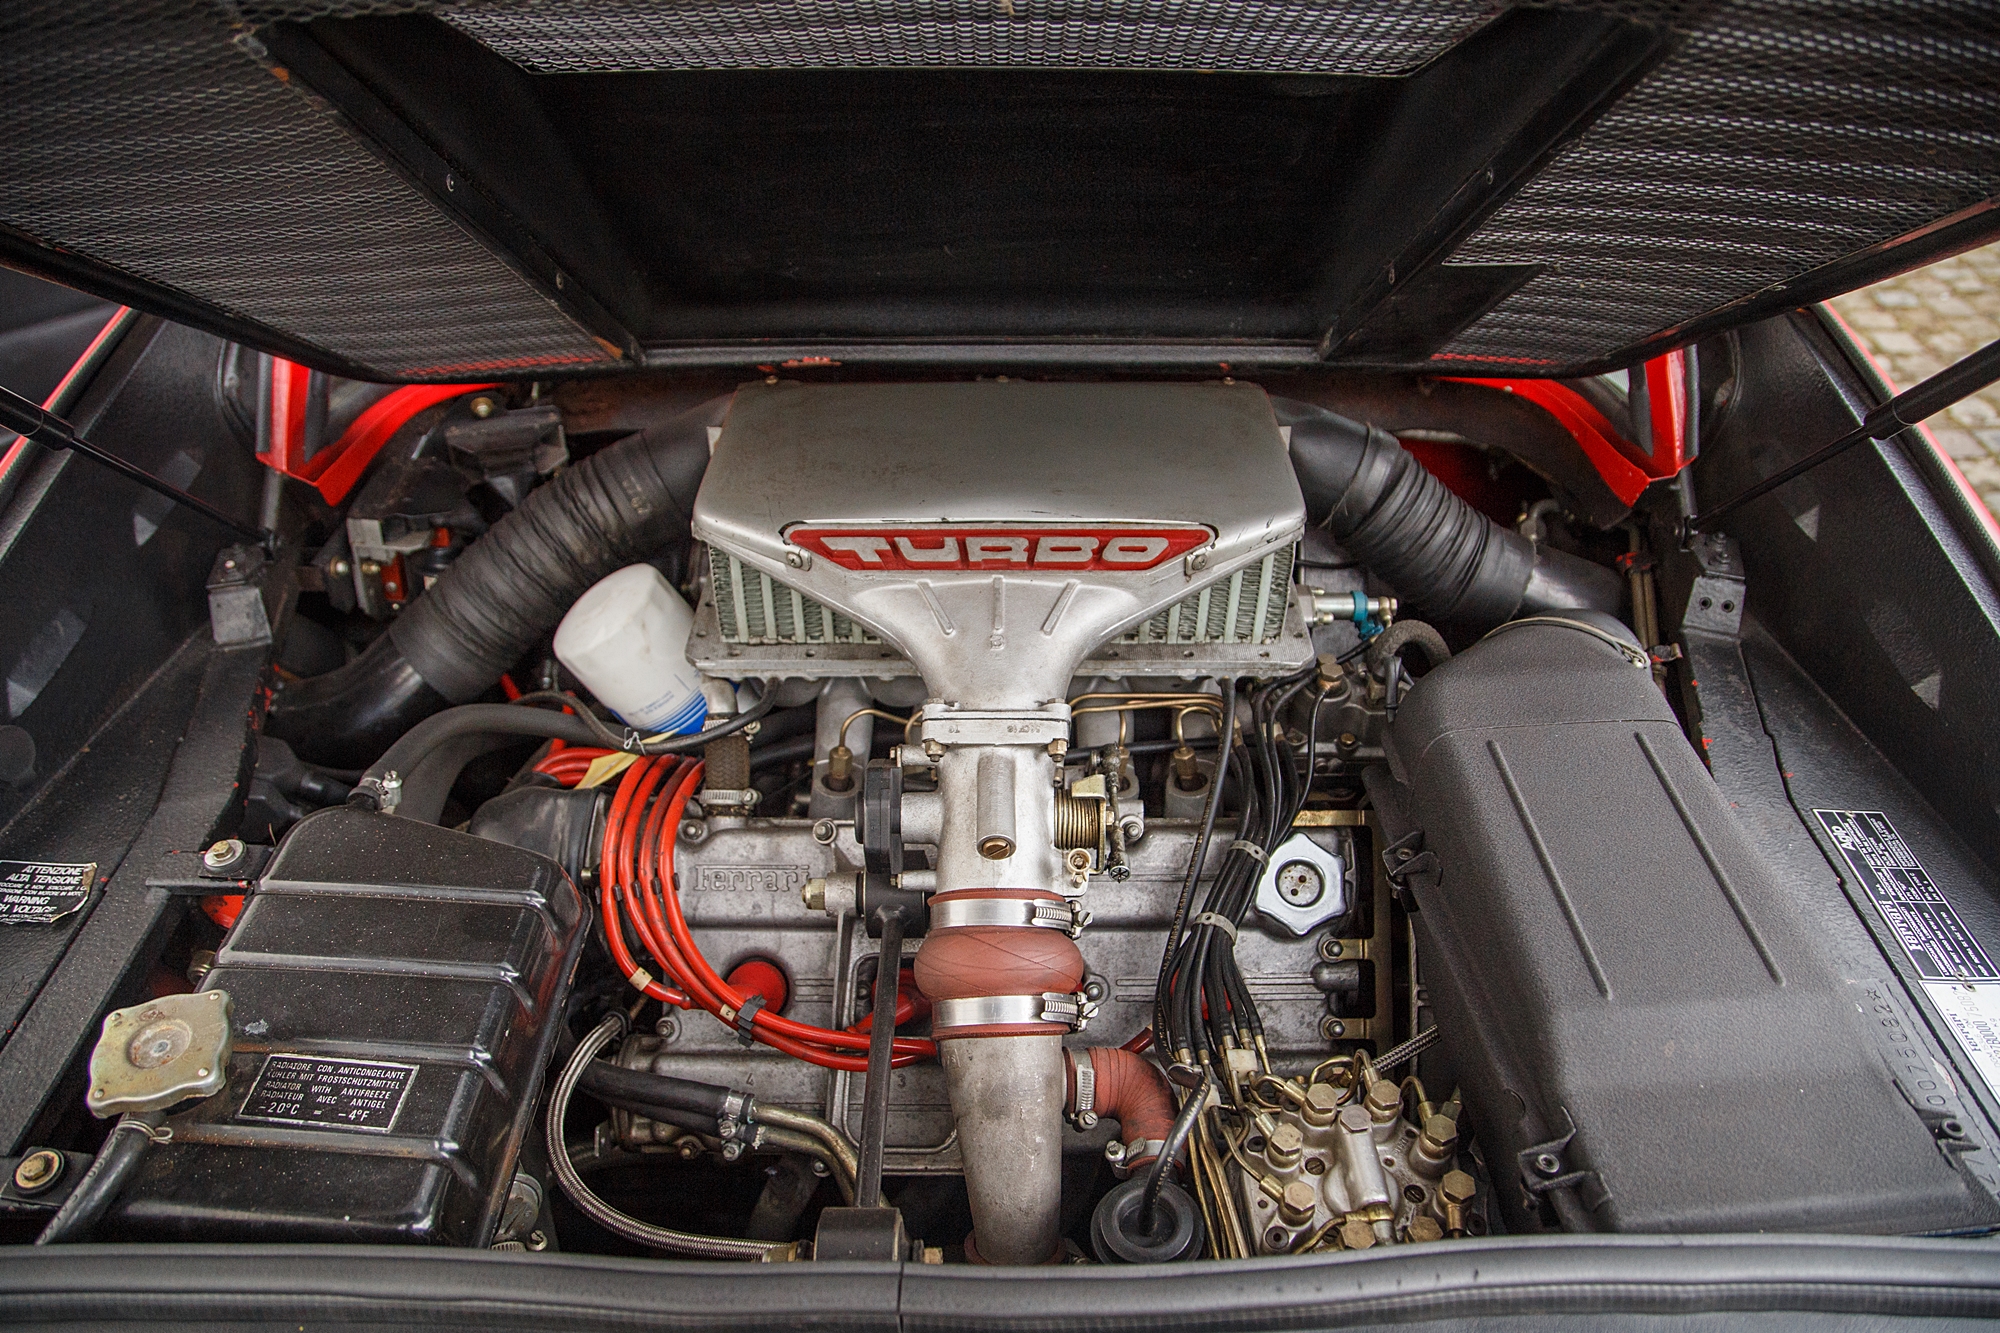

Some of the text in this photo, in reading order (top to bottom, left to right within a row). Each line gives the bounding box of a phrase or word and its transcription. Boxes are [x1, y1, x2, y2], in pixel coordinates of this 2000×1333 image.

[820, 536, 1169, 563] TURBO
[1831, 825, 1856, 850] Agip
[6, 873, 83, 884] ALTA TENSIONE
[22, 865, 84, 875] ATTENZIONE
[694, 864, 810, 892] Ferrari
[3, 894, 51, 905] WARNING
[1878, 900, 1924, 951] Ferrari
[1946, 1012, 1982, 1052] Ferrari
[272, 1061, 312, 1071] RADIATORE
[338, 1066, 405, 1080] ANTICONGELANTE
[265, 1080, 391, 1099] RADIATOR WITH ANTIFREEZE
[299, 1073, 314, 1081] MIT
[317, 1074, 400, 1089] FROSTSCHUTZMITTEL
[260, 1090, 387, 1109] RADIATEUR AVEC ANTIGEL
